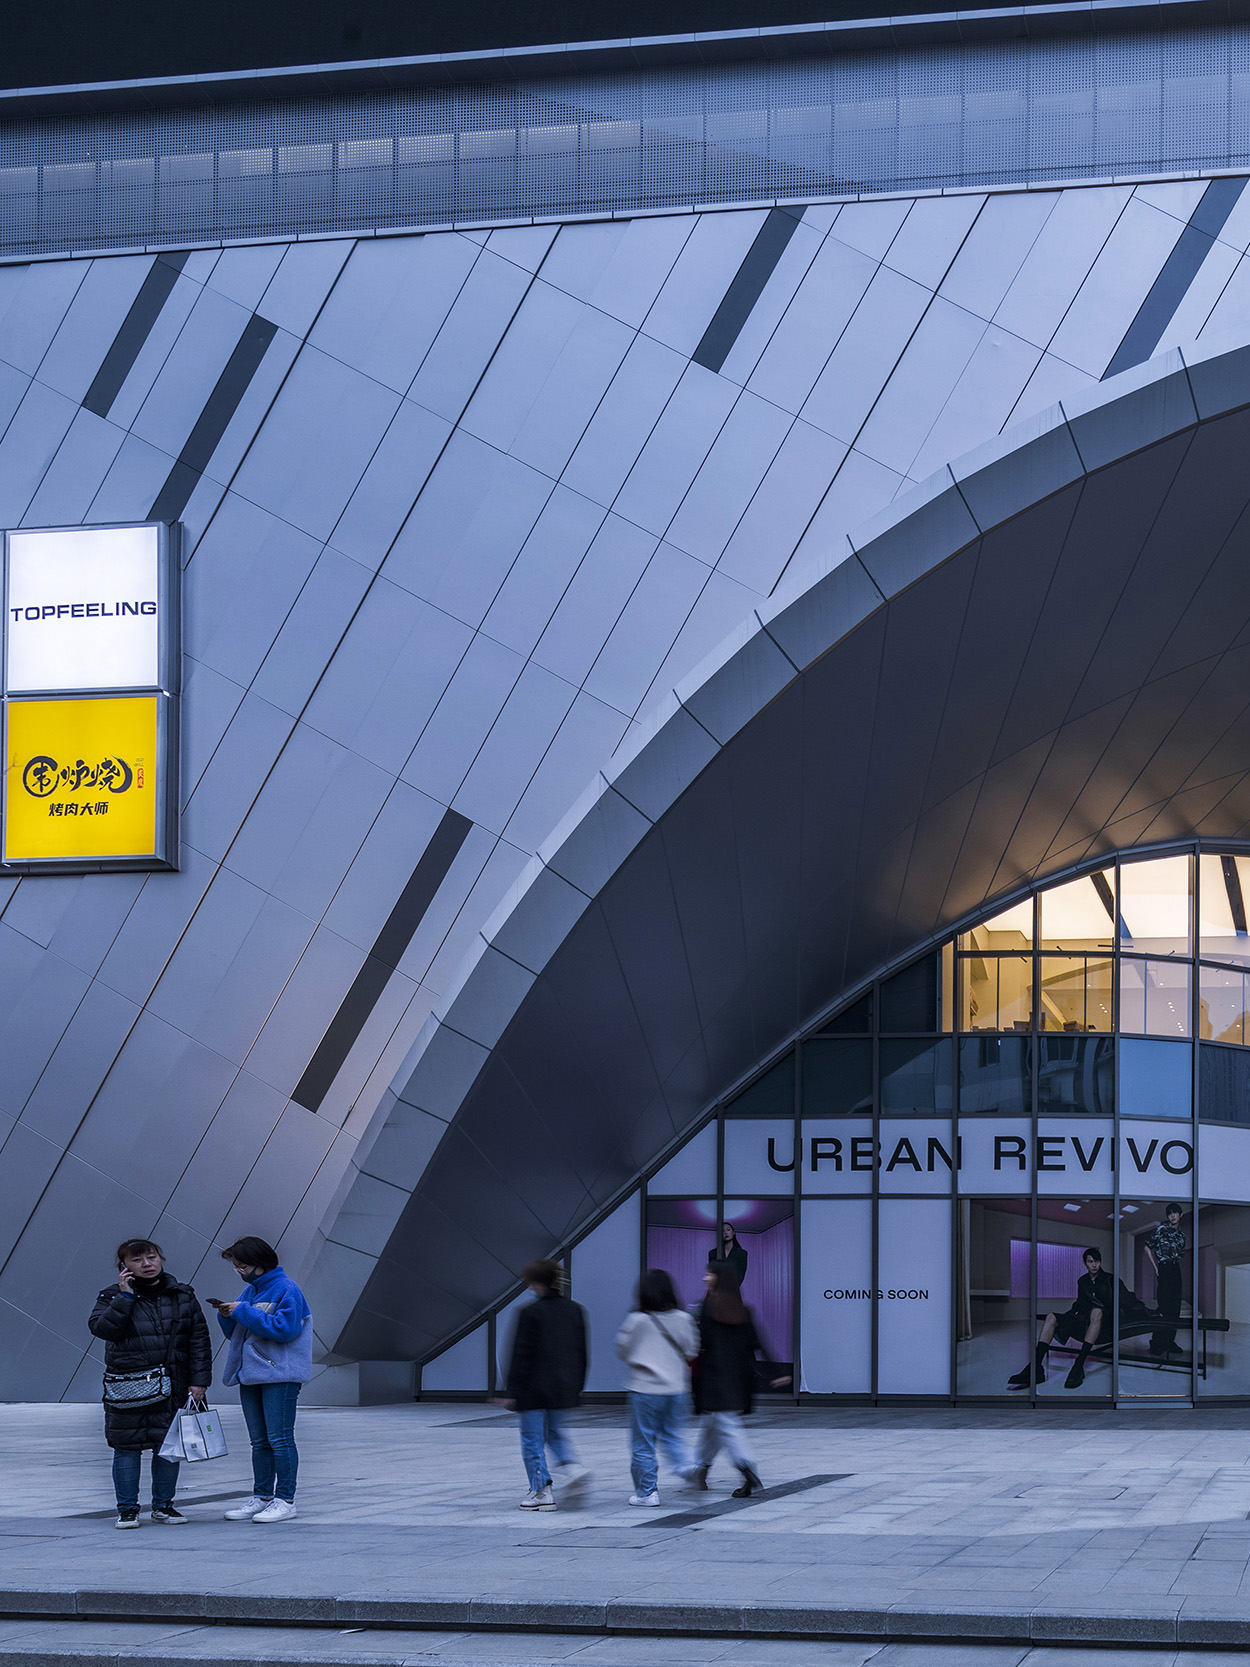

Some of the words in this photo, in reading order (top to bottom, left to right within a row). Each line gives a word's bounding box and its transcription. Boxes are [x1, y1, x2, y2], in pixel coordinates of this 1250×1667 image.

[10, 601, 157, 622] TOPFEELING
[48, 801, 109, 817] 烤肉大师
[766, 1135, 962, 1173] URBAN
[993, 1135, 1195, 1175] REVIVO
[823, 1289, 884, 1300] COMING
[887, 1289, 929, 1300] SOON
